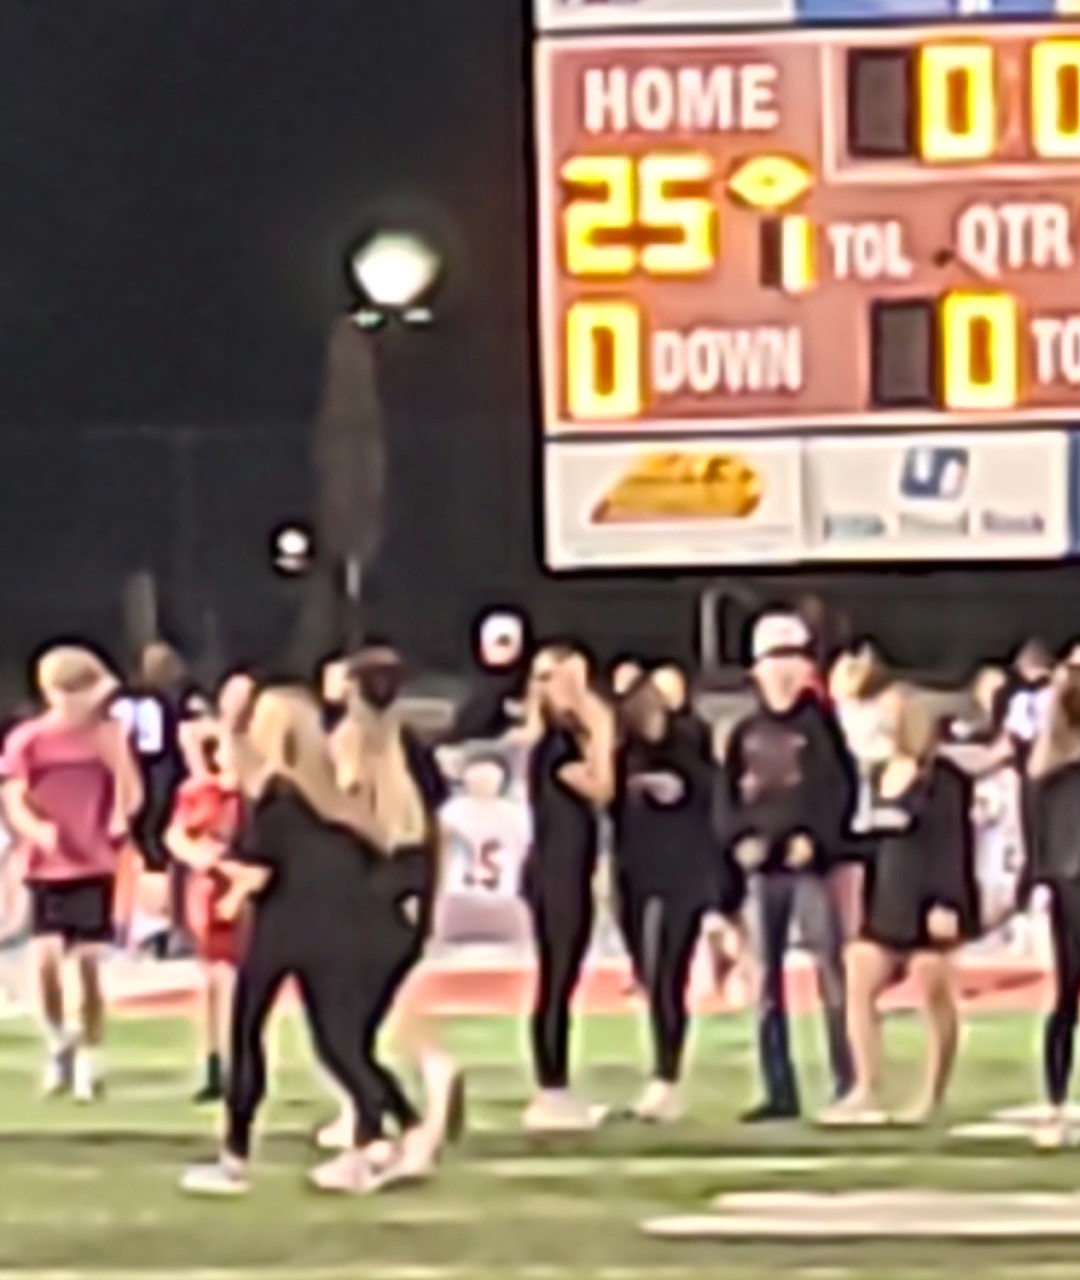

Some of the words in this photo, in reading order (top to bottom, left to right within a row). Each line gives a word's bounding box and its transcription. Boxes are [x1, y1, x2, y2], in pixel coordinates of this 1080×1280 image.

[584, 63, 780, 132] HOME
[562, 154, 716, 274] 25
[828, 222, 914, 276] TOL
[957, 202, 1072, 277] QTR
[566, 302, 642, 418] 0
[652, 326, 801, 393] DOWN
[943, 291, 1019, 409] 0
